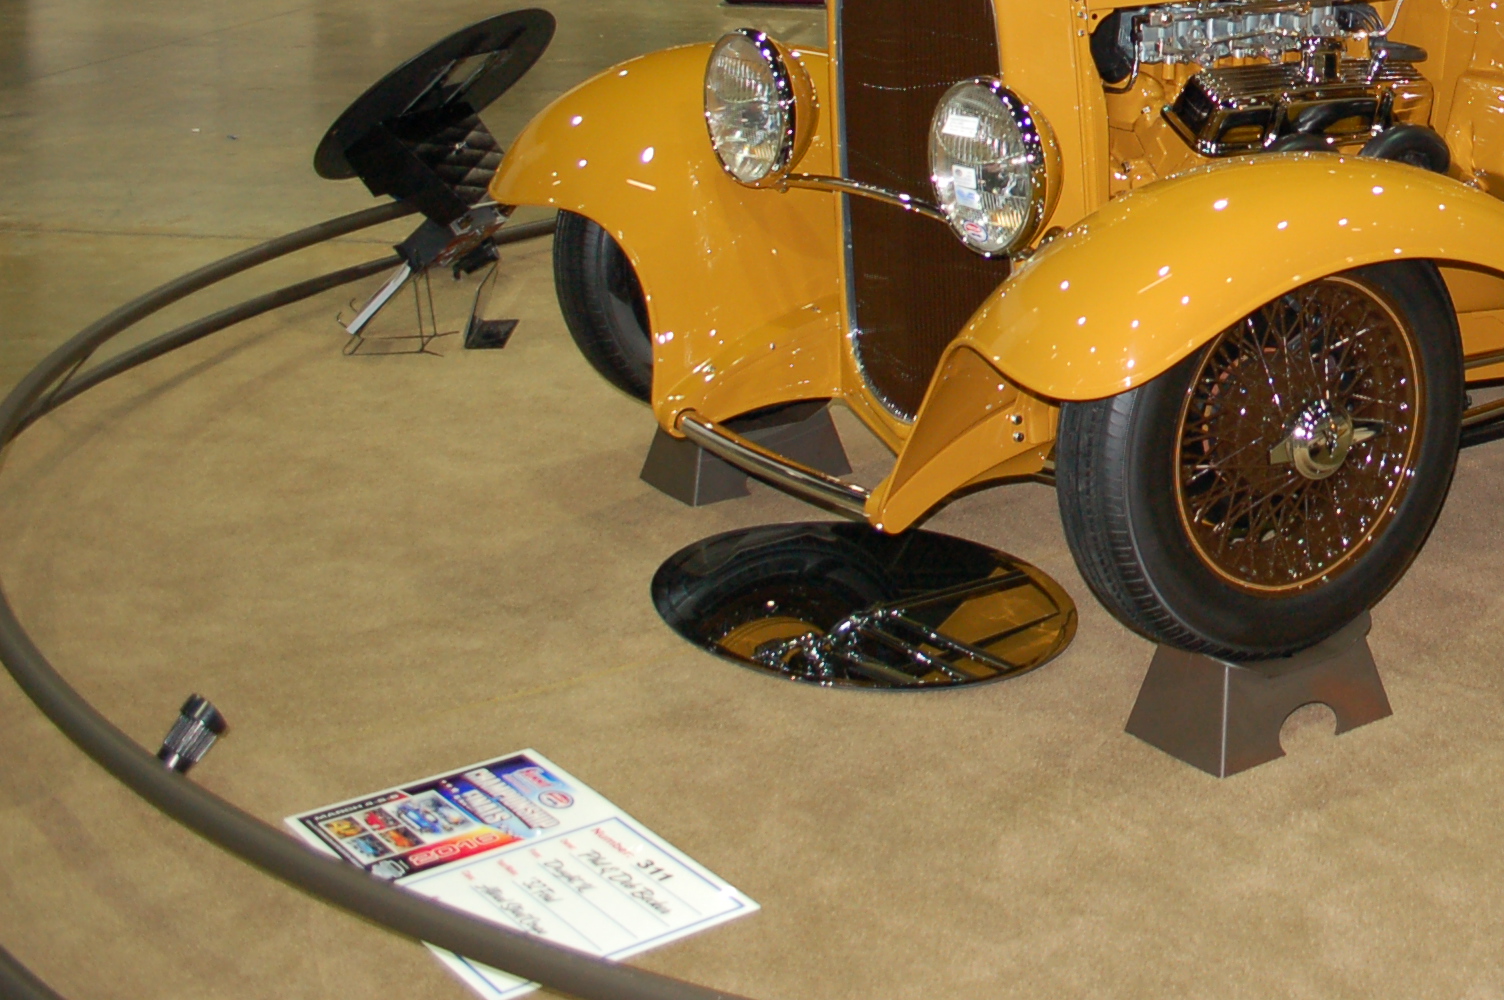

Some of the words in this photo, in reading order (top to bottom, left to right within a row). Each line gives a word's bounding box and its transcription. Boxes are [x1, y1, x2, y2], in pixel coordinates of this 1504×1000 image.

[313, 803, 364, 820] MARCH
[458, 789, 513, 824] FINALS
[461, 767, 561, 830] CHAMPIONSHIP
[408, 832, 502, 867] 2016
[636, 857, 675, 883] 311
